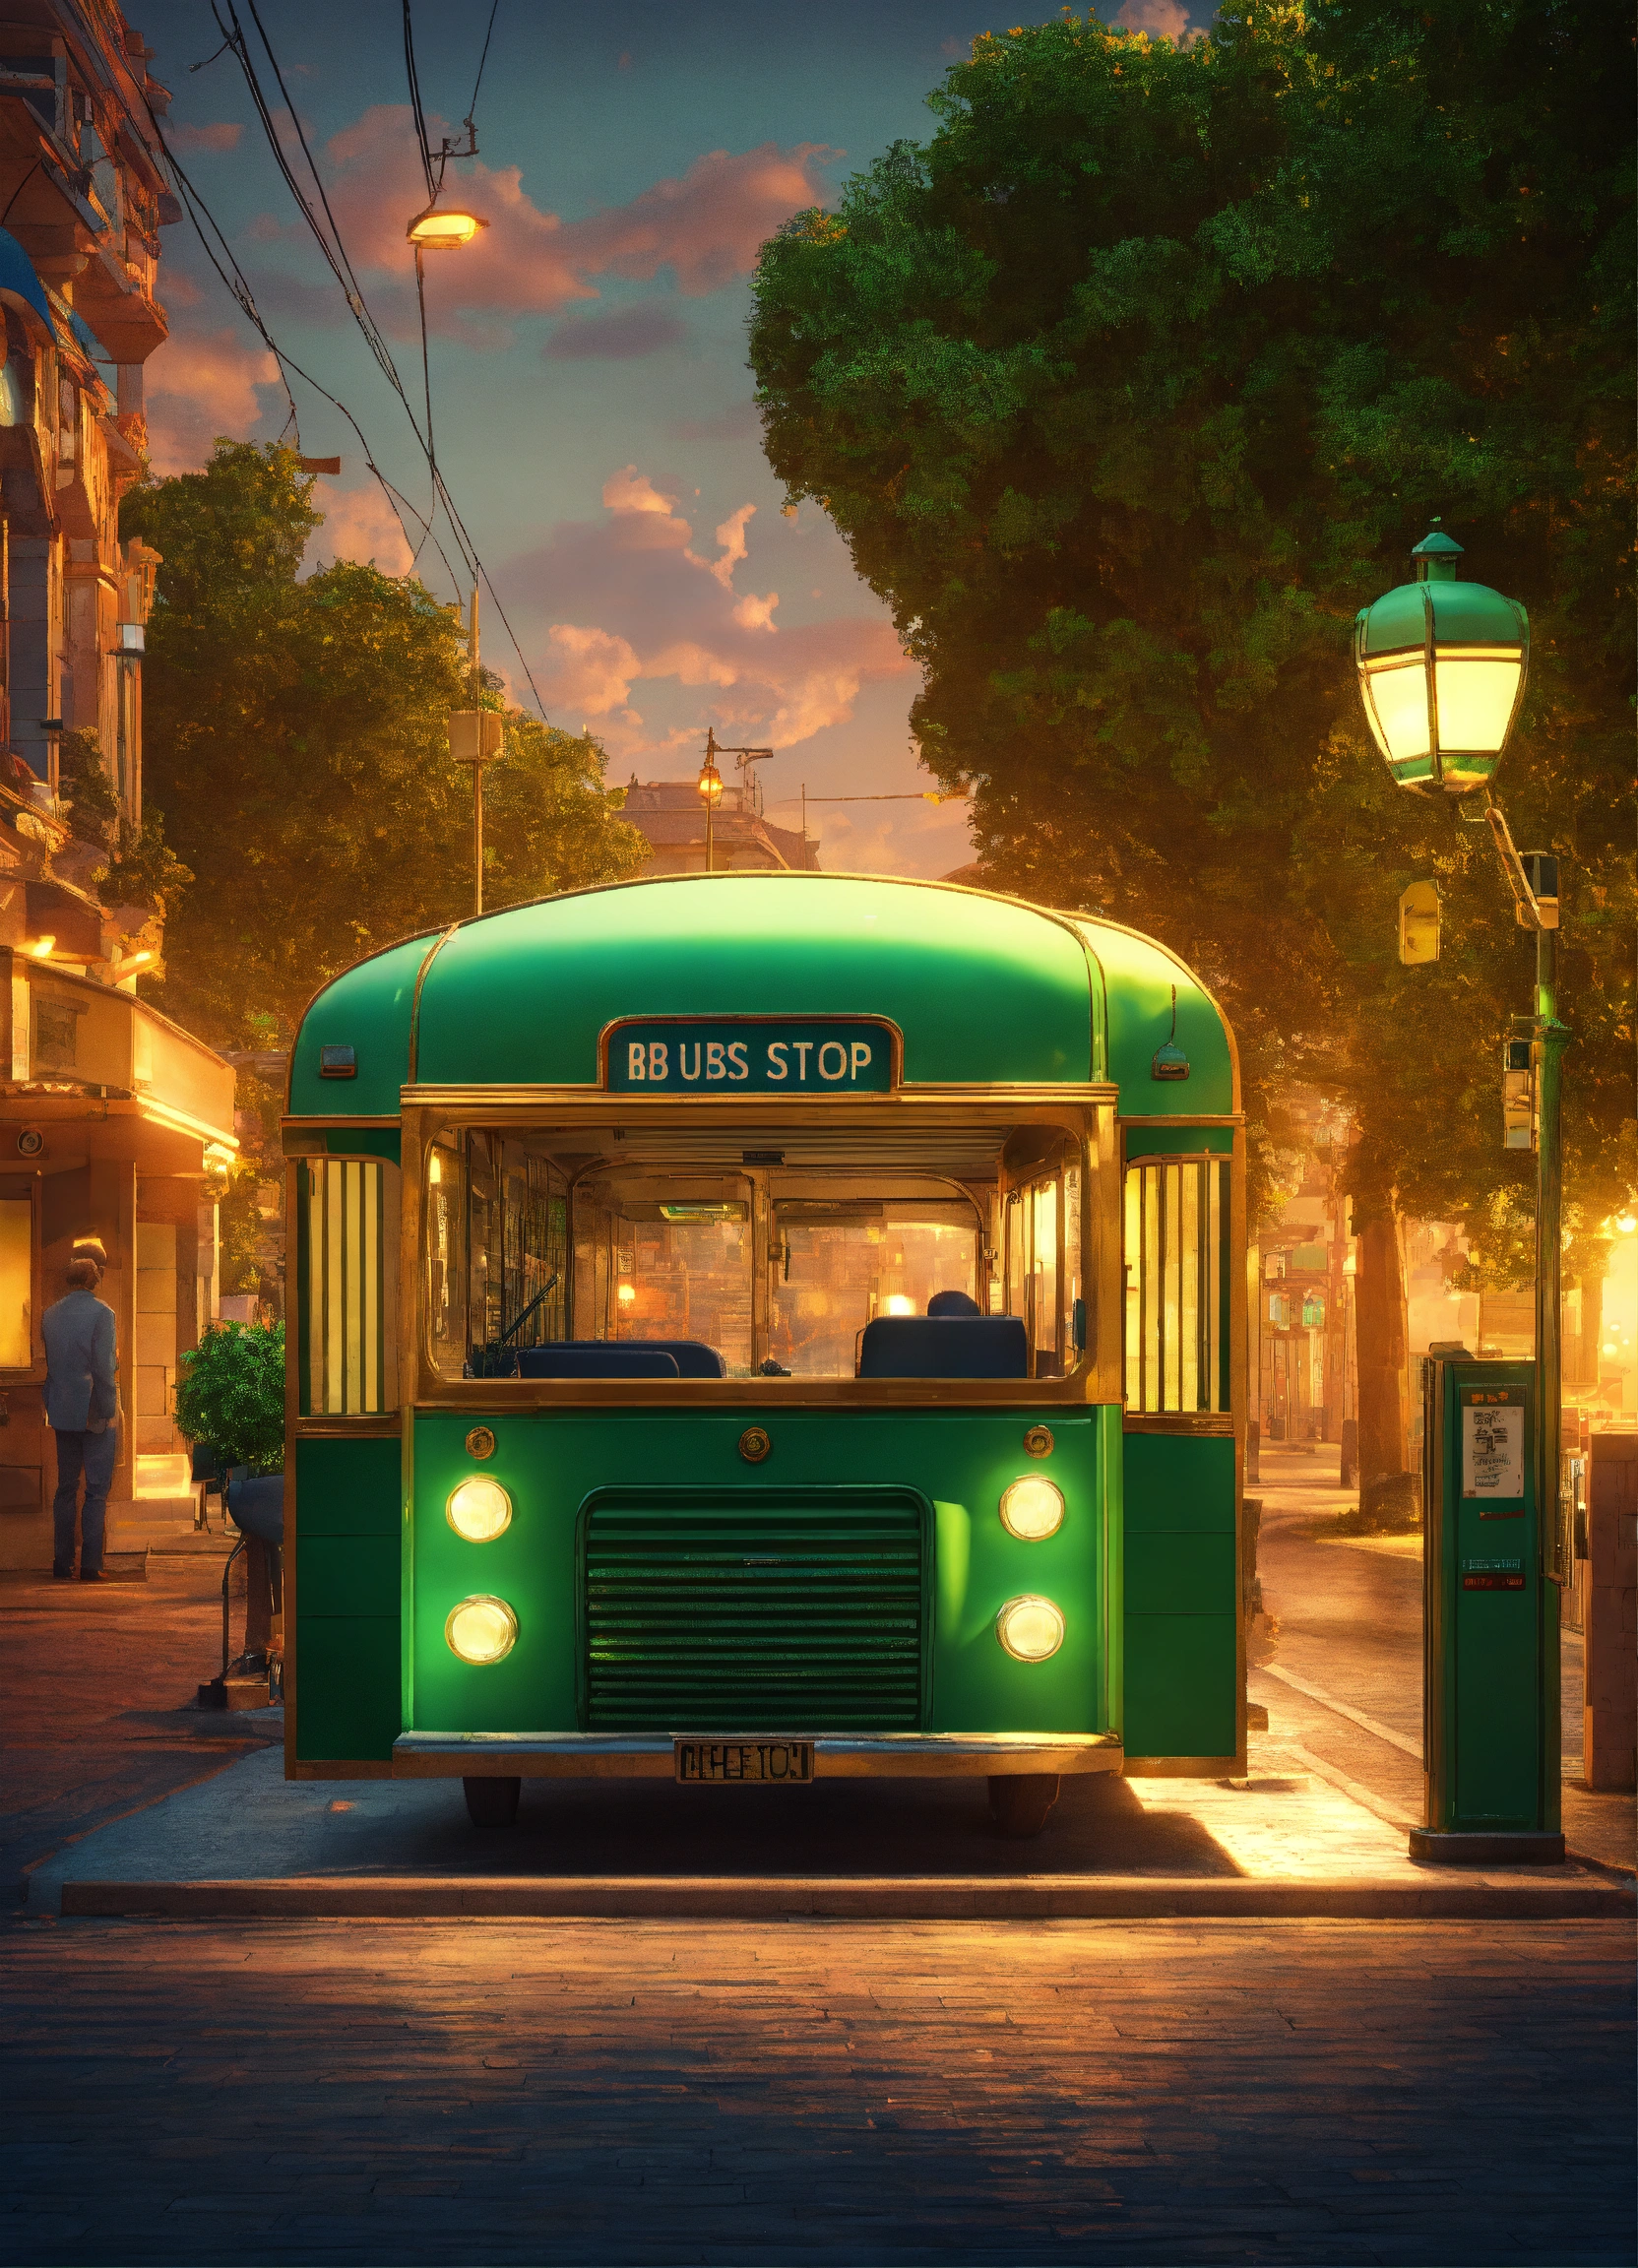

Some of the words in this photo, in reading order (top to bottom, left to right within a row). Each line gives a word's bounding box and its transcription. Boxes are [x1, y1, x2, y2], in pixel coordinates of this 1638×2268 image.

[628, 1042, 668, 1080] BB
[680, 1041, 749, 1080] UBS
[767, 1041, 872, 1080] STOP
